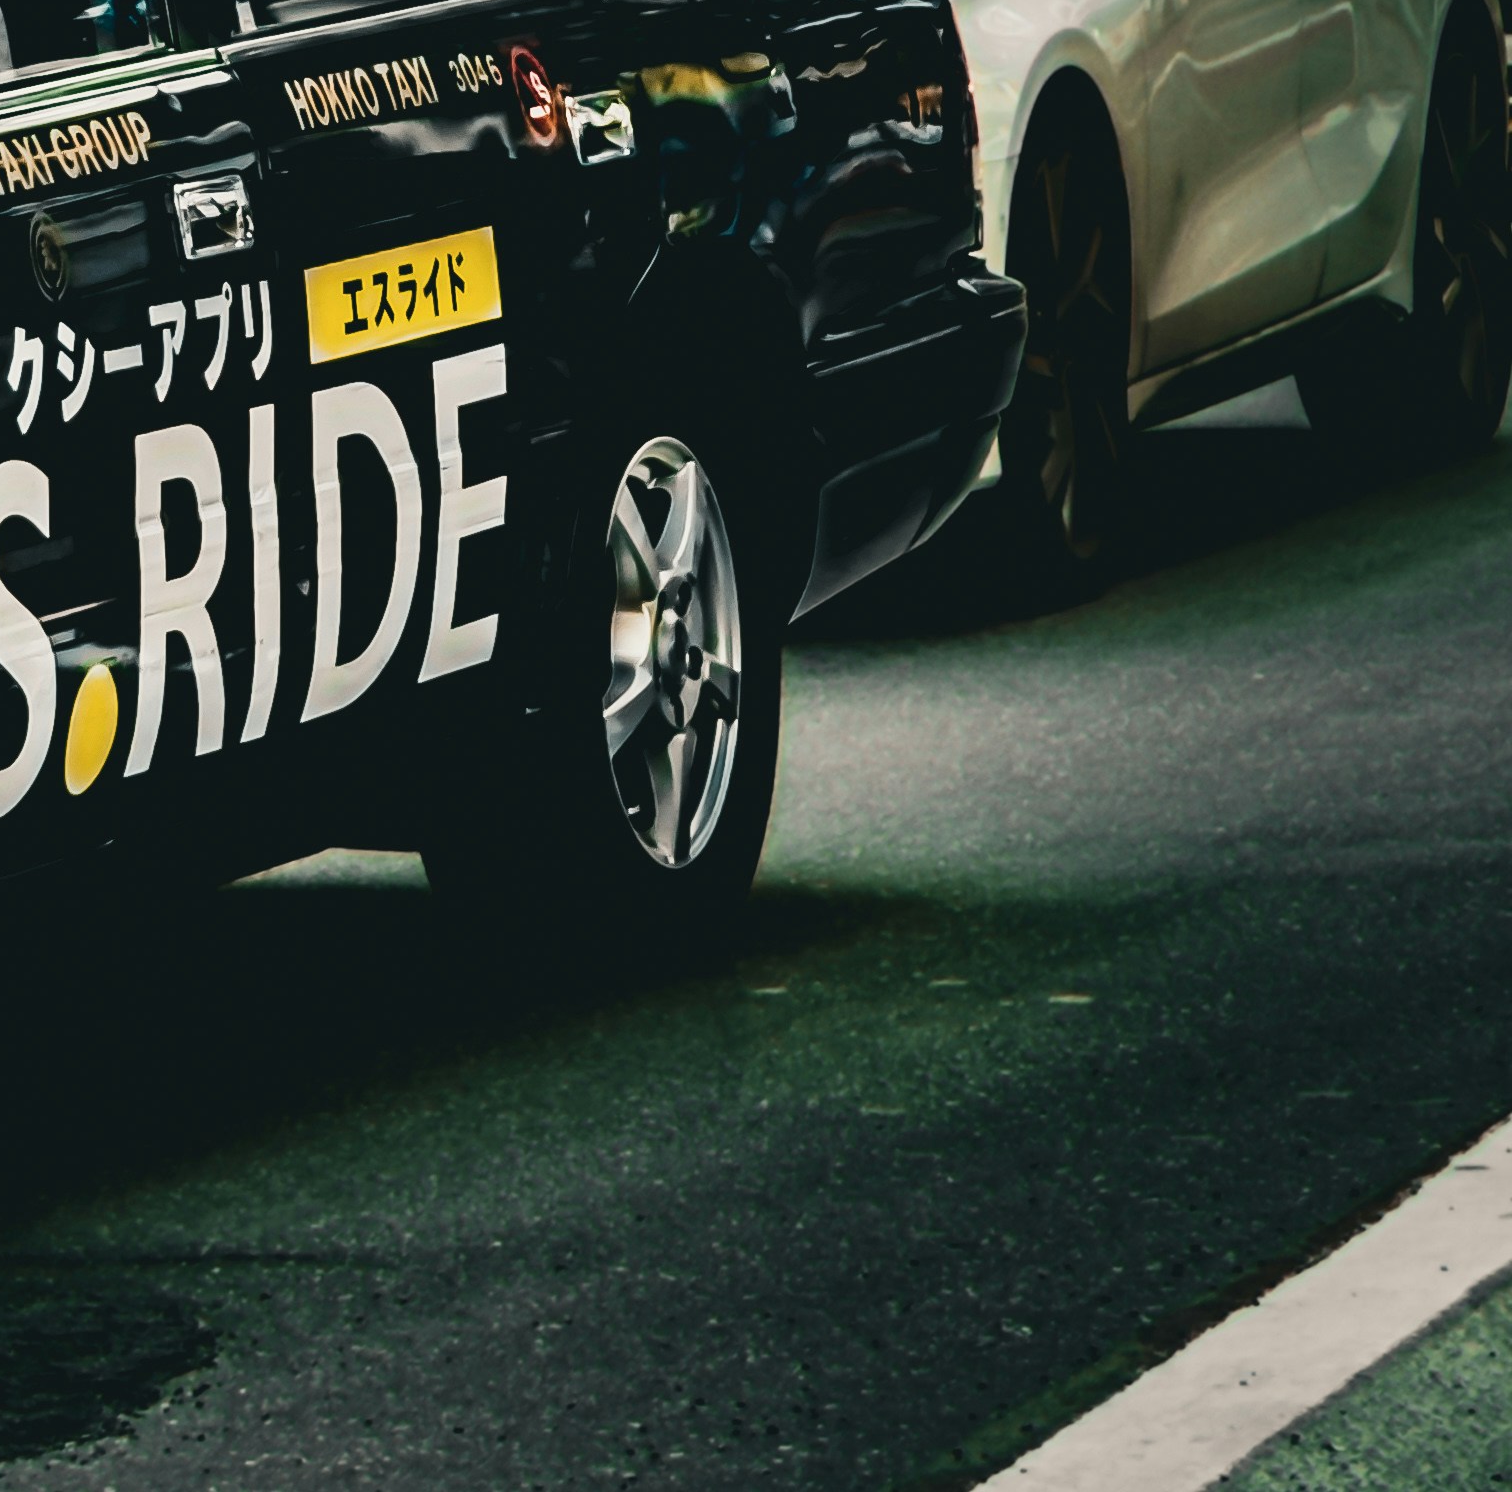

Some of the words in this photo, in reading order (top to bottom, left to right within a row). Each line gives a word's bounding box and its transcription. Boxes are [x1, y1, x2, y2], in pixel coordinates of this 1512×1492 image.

[283, 67, 380, 131] HOKKO
[374, 55, 440, 111] TAXI
[448, 52, 503, 94] 3046
[49, 111, 151, 179] GROUP
[341, 250, 467, 336] エスライド
